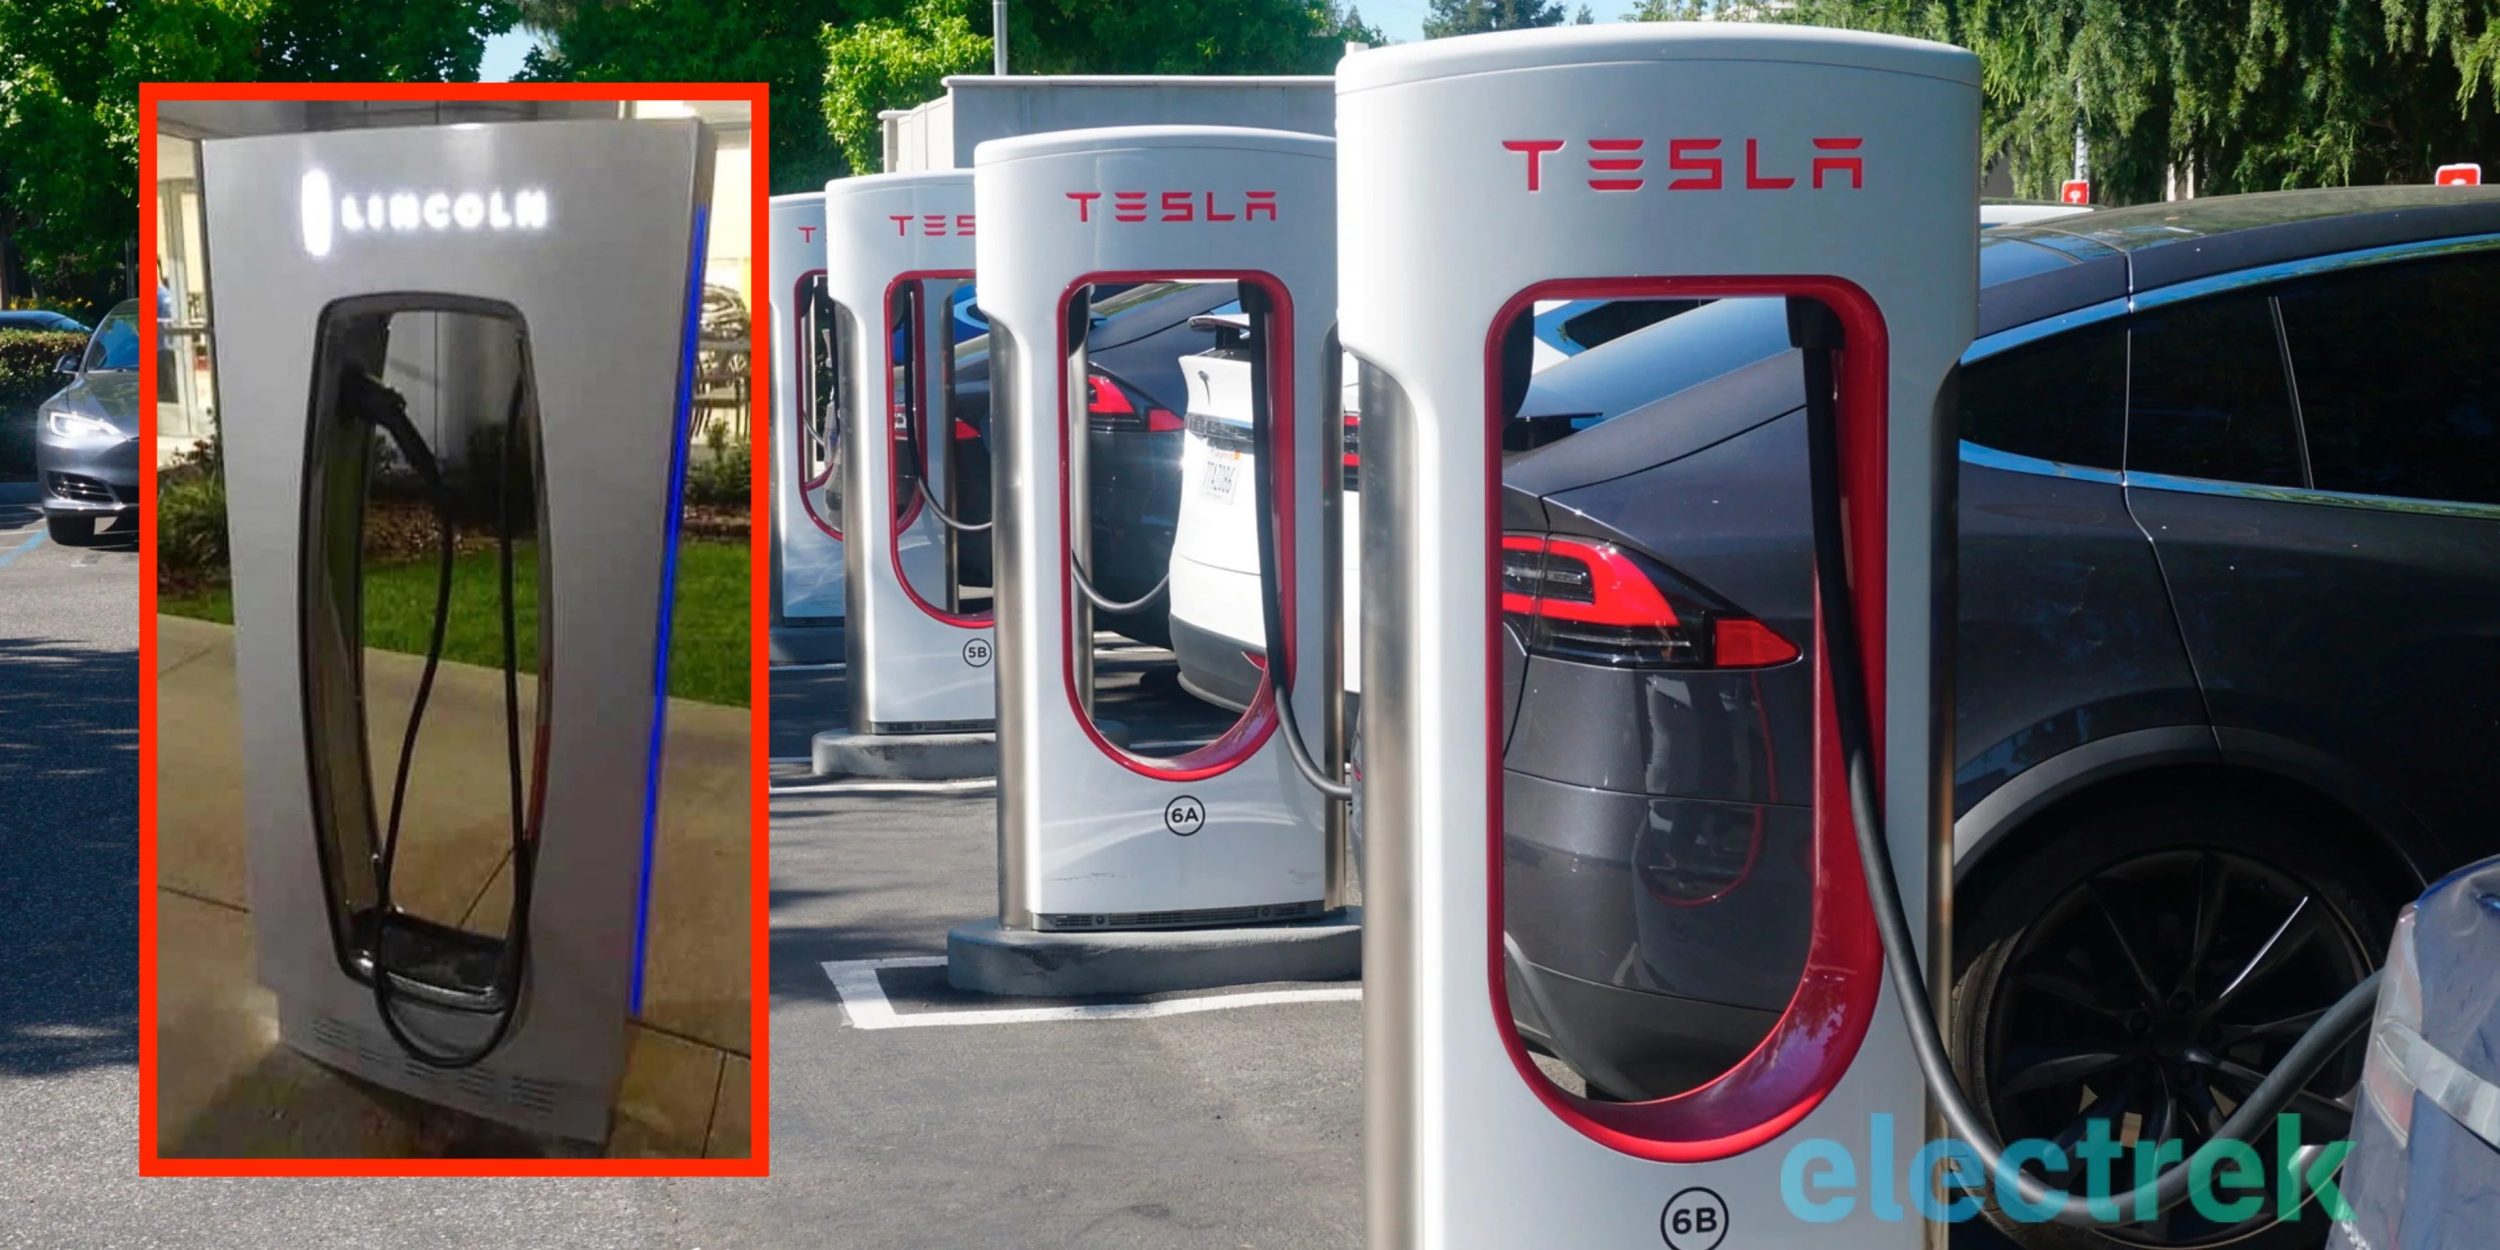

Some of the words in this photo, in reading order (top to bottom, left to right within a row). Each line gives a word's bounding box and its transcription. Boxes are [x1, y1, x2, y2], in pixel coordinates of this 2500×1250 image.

[1501, 137, 1863, 193] TESLA
[340, 189, 548, 233] LINCOLN
[1065, 191, 1277, 223] TESLA
[968, 646, 987, 658] 5B
[1171, 807, 1199, 823] 6A
[1672, 1206, 1718, 1235] 6B
